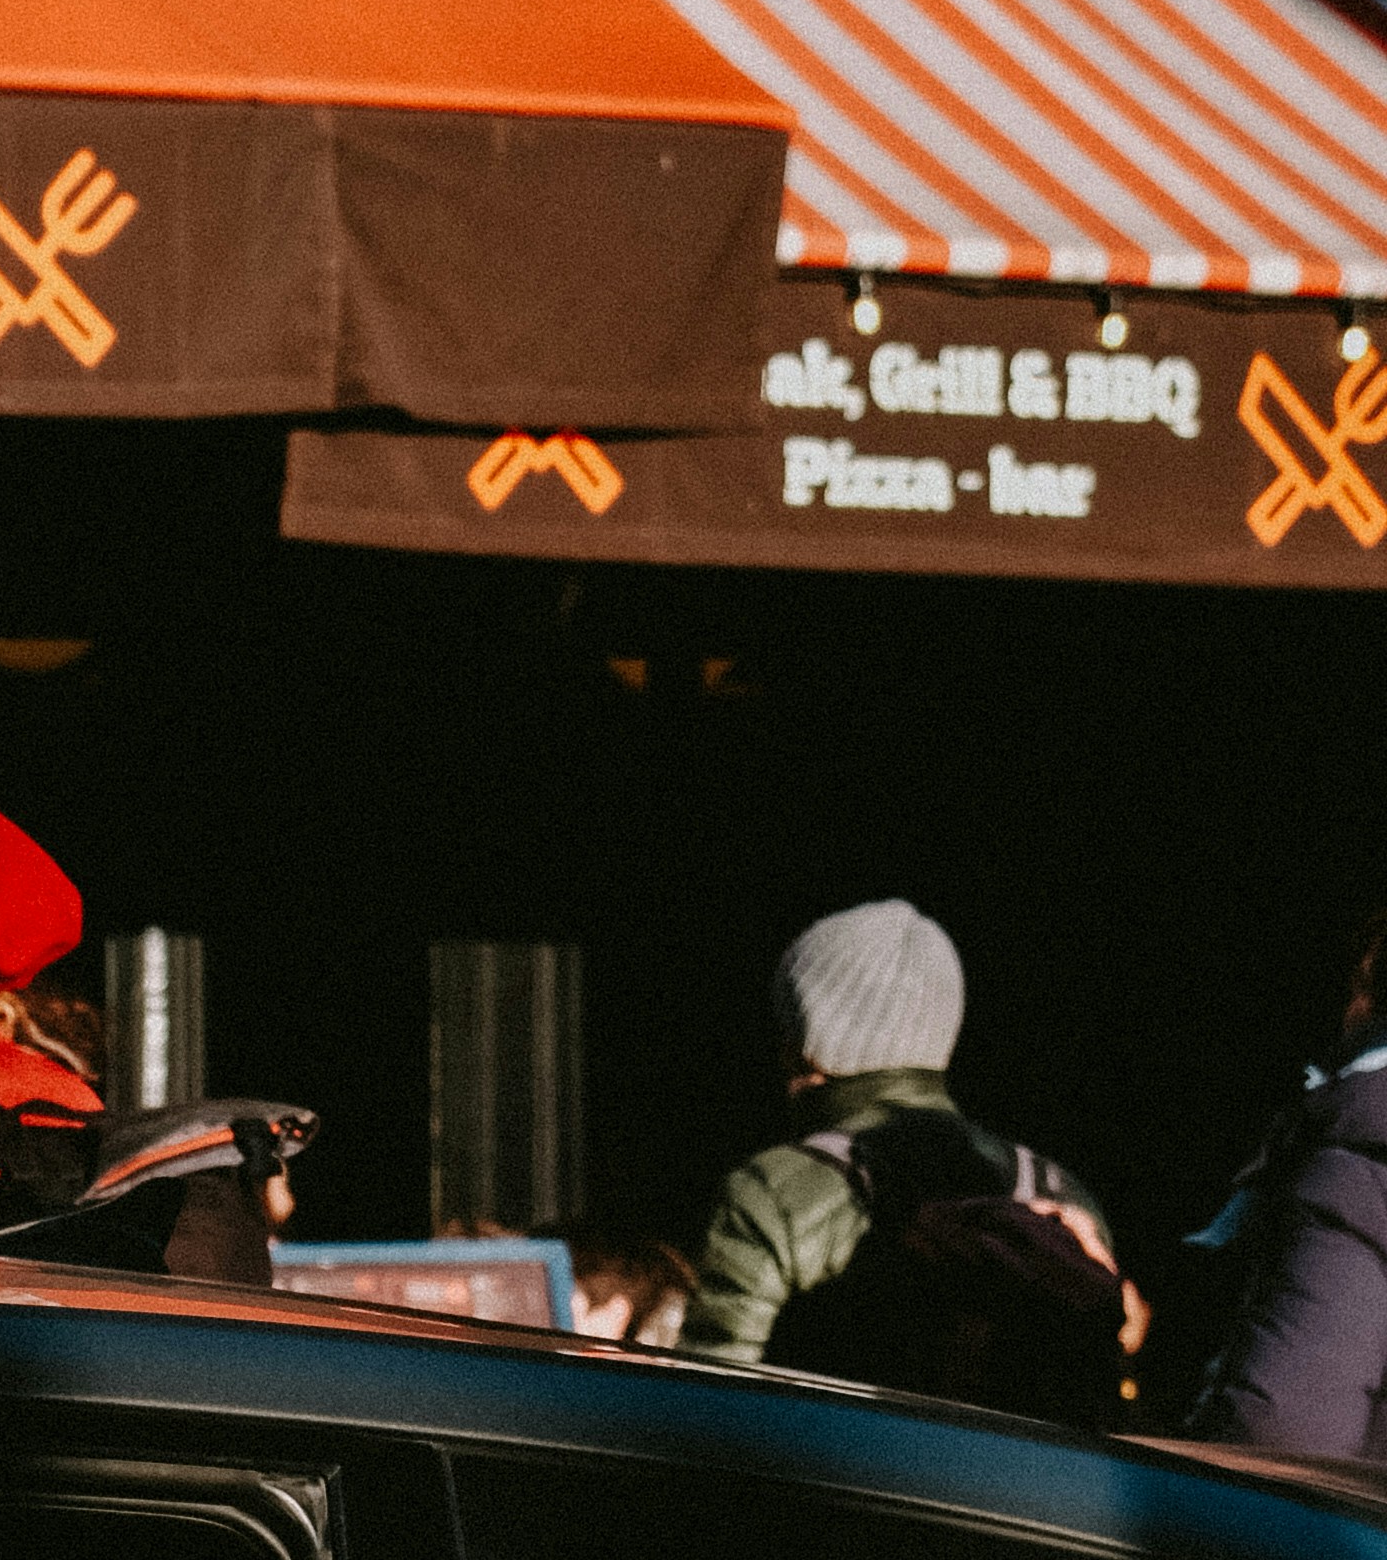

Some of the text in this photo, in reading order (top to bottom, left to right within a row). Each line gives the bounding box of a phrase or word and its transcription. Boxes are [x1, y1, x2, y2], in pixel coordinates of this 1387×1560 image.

[870, 343, 1003, 416] Grill
[1007, 351, 1060, 419] &
[1065, 352, 1200, 438] BBQ
[783, 437, 953, 512] Pizza
[987, 445, 1095, 518] bar
